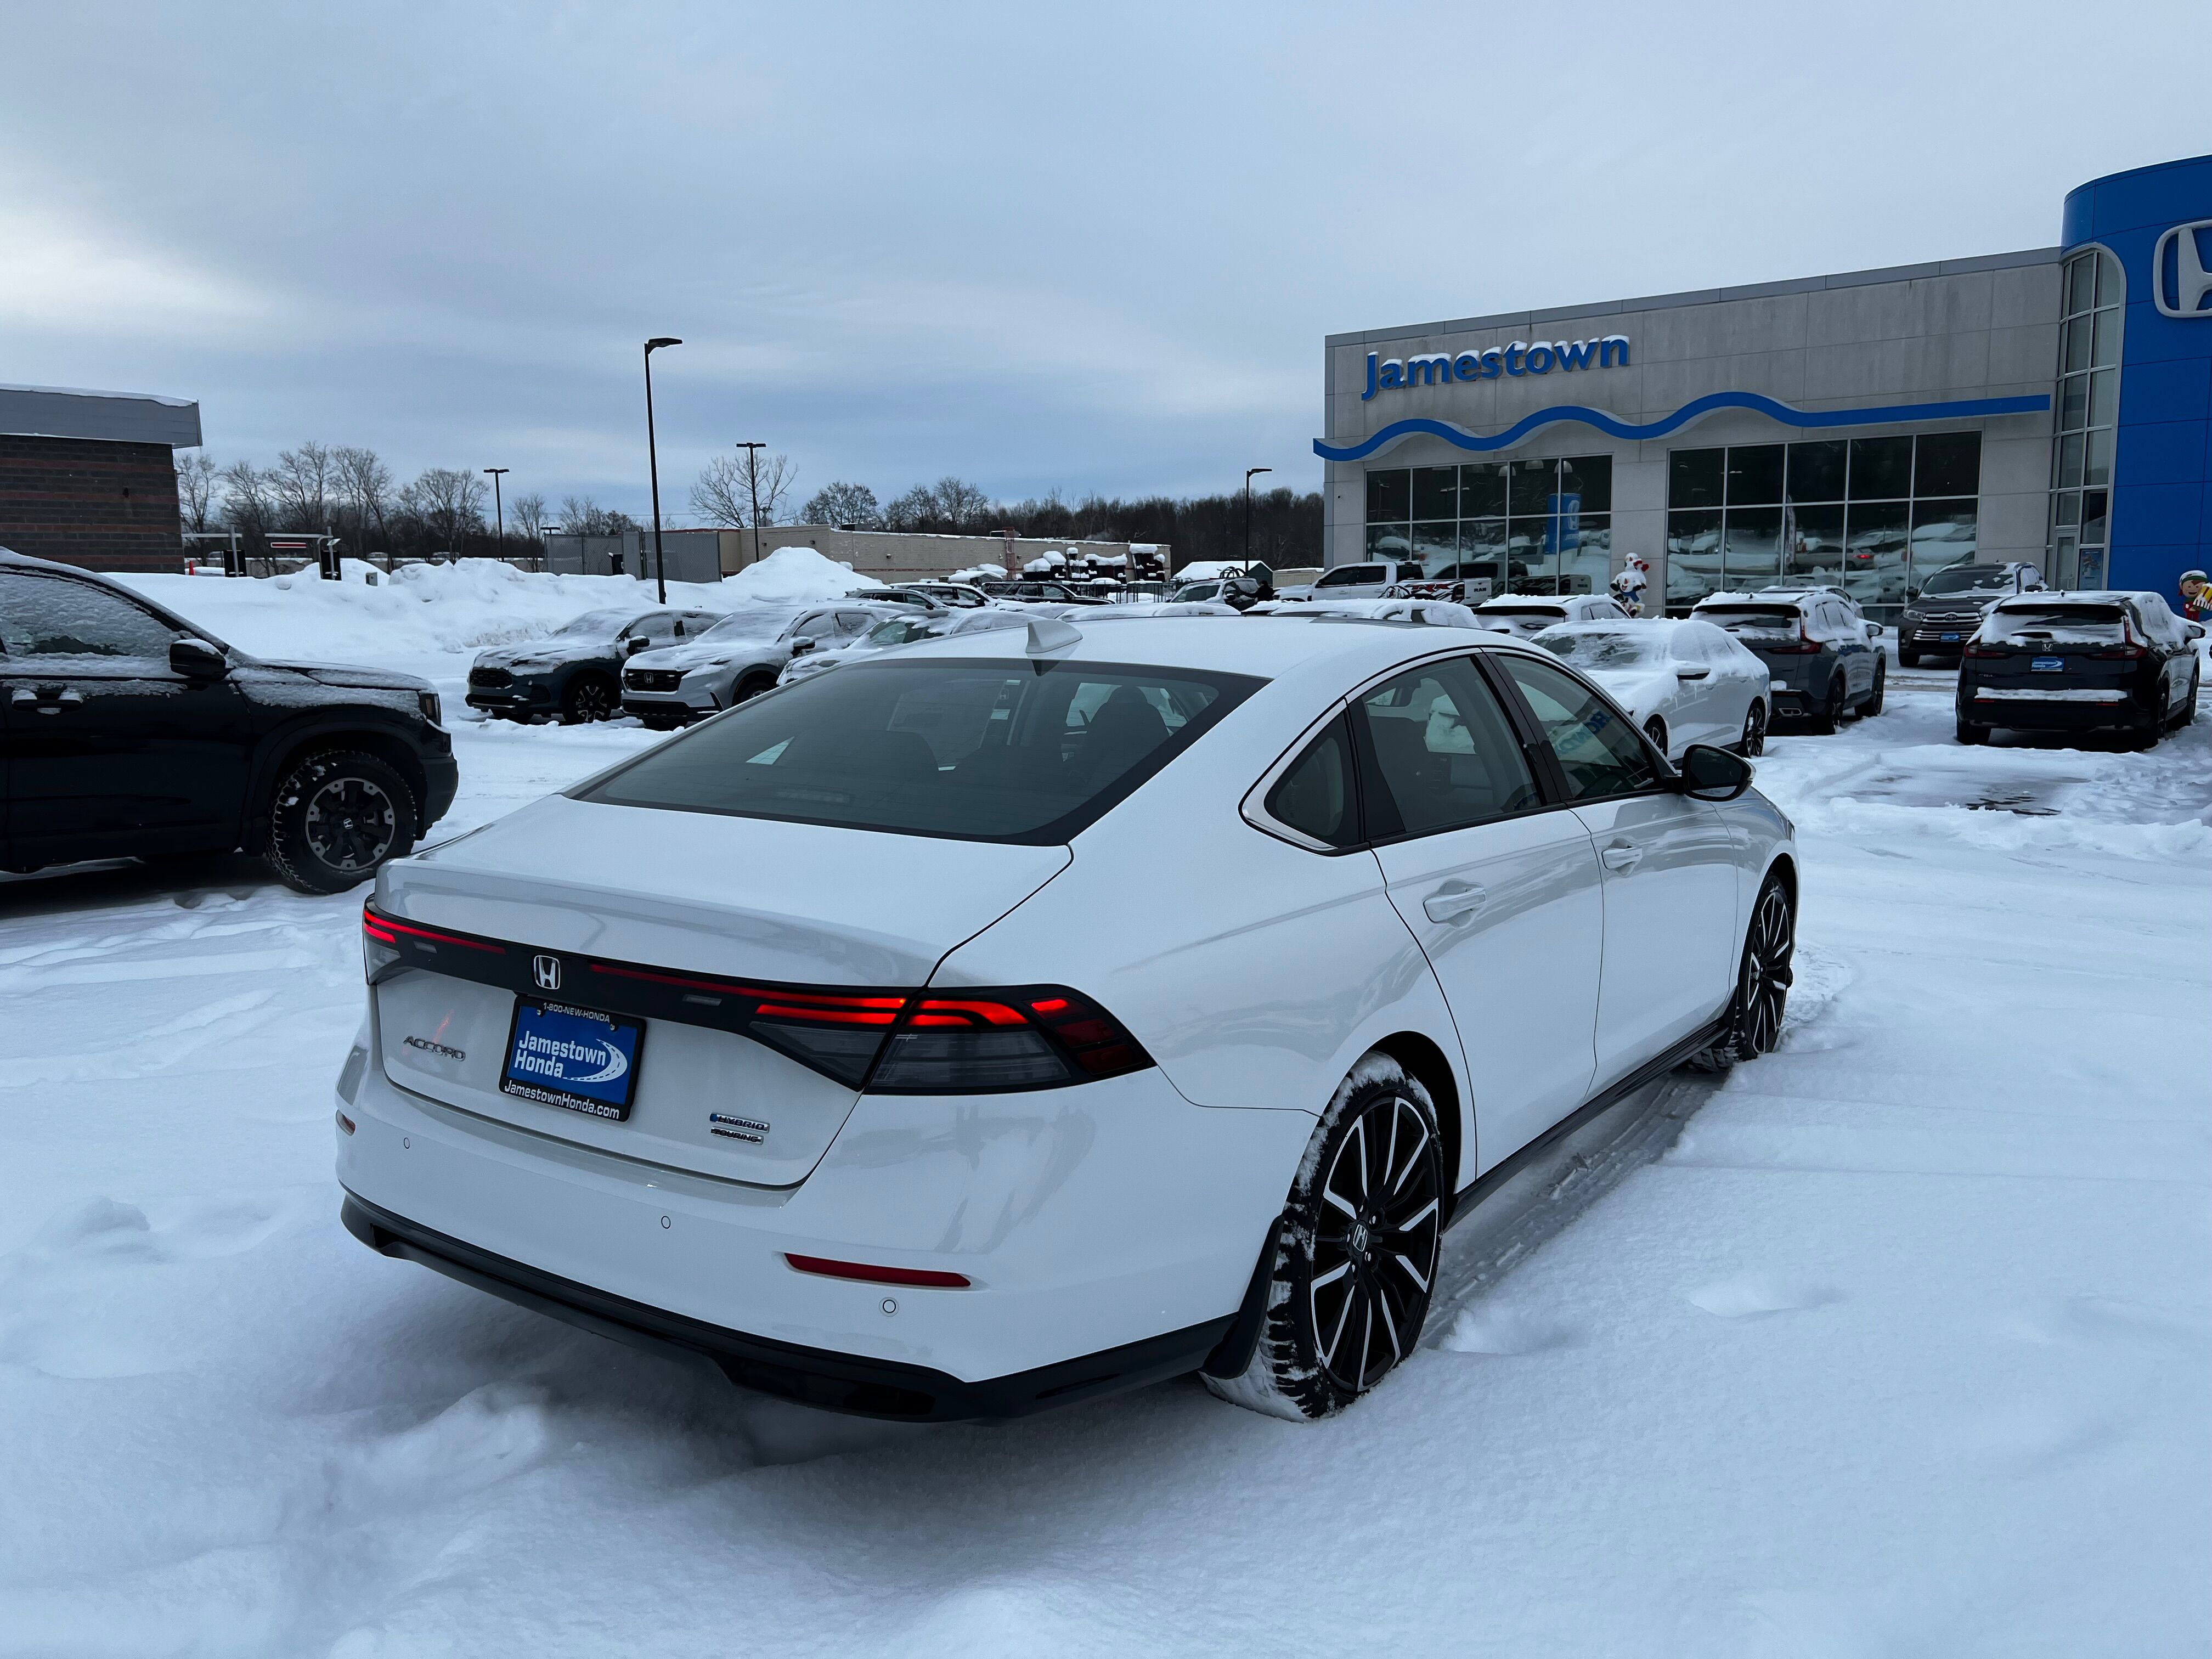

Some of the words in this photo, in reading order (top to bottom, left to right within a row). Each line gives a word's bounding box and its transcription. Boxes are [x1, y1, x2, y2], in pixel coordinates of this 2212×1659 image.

[1361, 336, 1629, 400] Jamestown
[543, 1002, 610, 1023] 1-800-NEW-HONDA
[403, 1036, 466, 1061] ACCORD
[519, 1031, 606, 1066] Jamestown
[514, 1049, 564, 1077] Honda
[504, 1080, 619, 1119] JamestownHonda.com
[711, 1128, 760, 1143] TOURING
[717, 1115, 766, 1131] HYBRID
